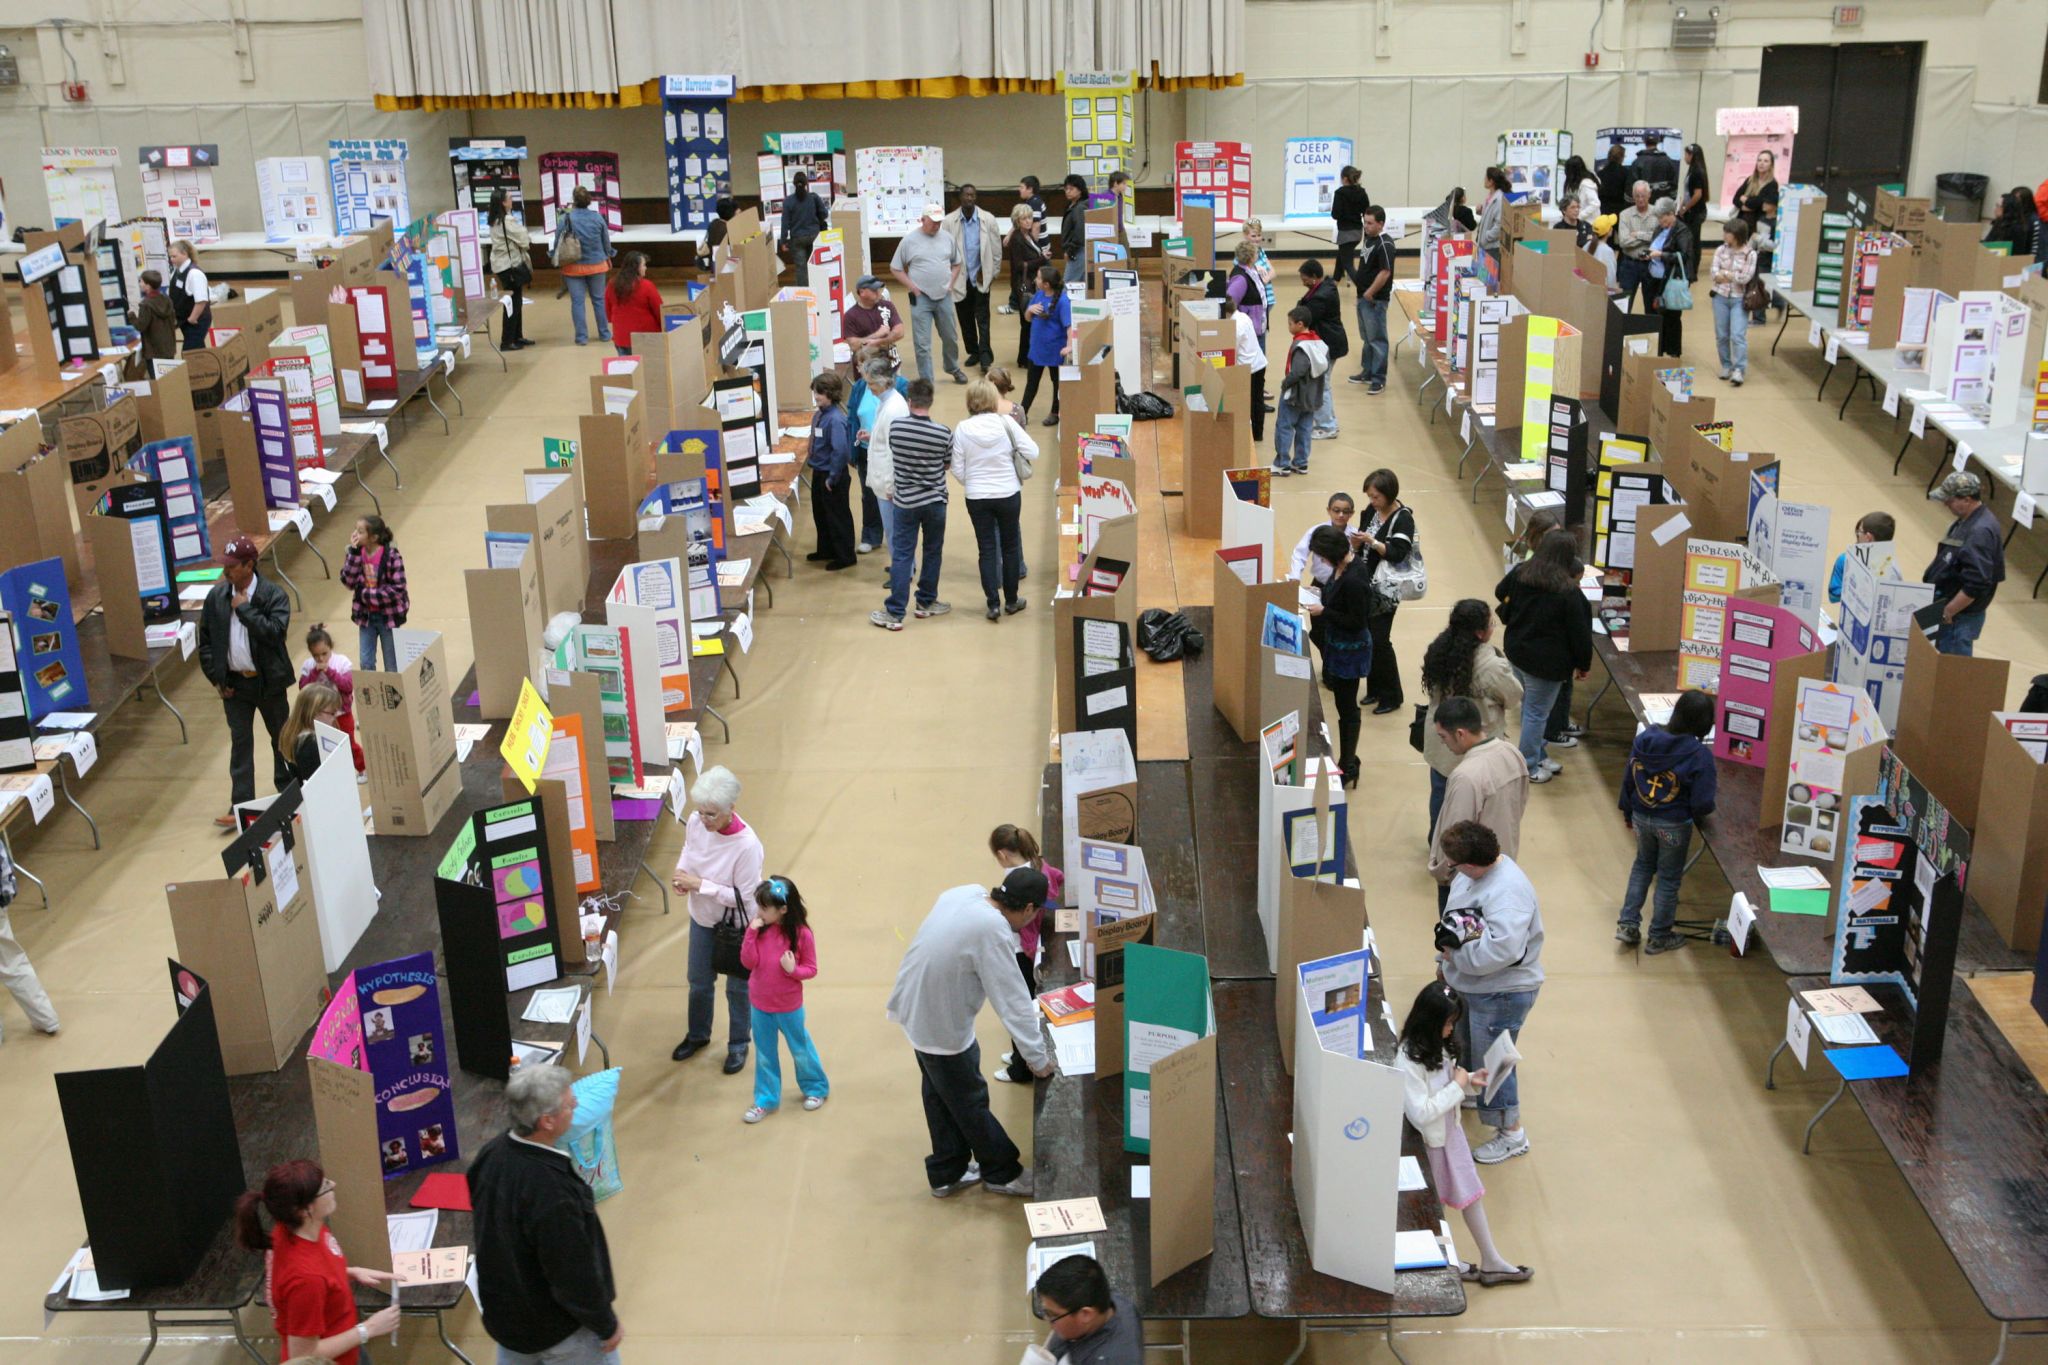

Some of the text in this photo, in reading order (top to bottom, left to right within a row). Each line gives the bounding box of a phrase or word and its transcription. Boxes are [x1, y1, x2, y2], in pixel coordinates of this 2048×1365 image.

[1068, 74, 1110, 84] Acid Rain
[1300, 143, 1329, 152] DEEP
[1294, 154, 1332, 164] CLEAN
[1082, 481, 1120, 499] WHICH
[1782, 506, 1803, 514] Office
[1688, 545, 1740, 557] PROBLEM
[1684, 593, 1726, 607] HYPOTHE
[1680, 642, 1721, 658] EXPERIM
[36, 789, 48, 803] 140
[1862, 869, 1897, 877] PROBLEM
[1856, 916, 1895, 924] MATERIALS
[1097, 918, 1148, 938] Display Board
[358, 971, 437, 995] HYPOTHESIS
[1148, 1031, 1177, 1040] PURPOSE
[374, 1073, 450, 1104] CONCLUSION
